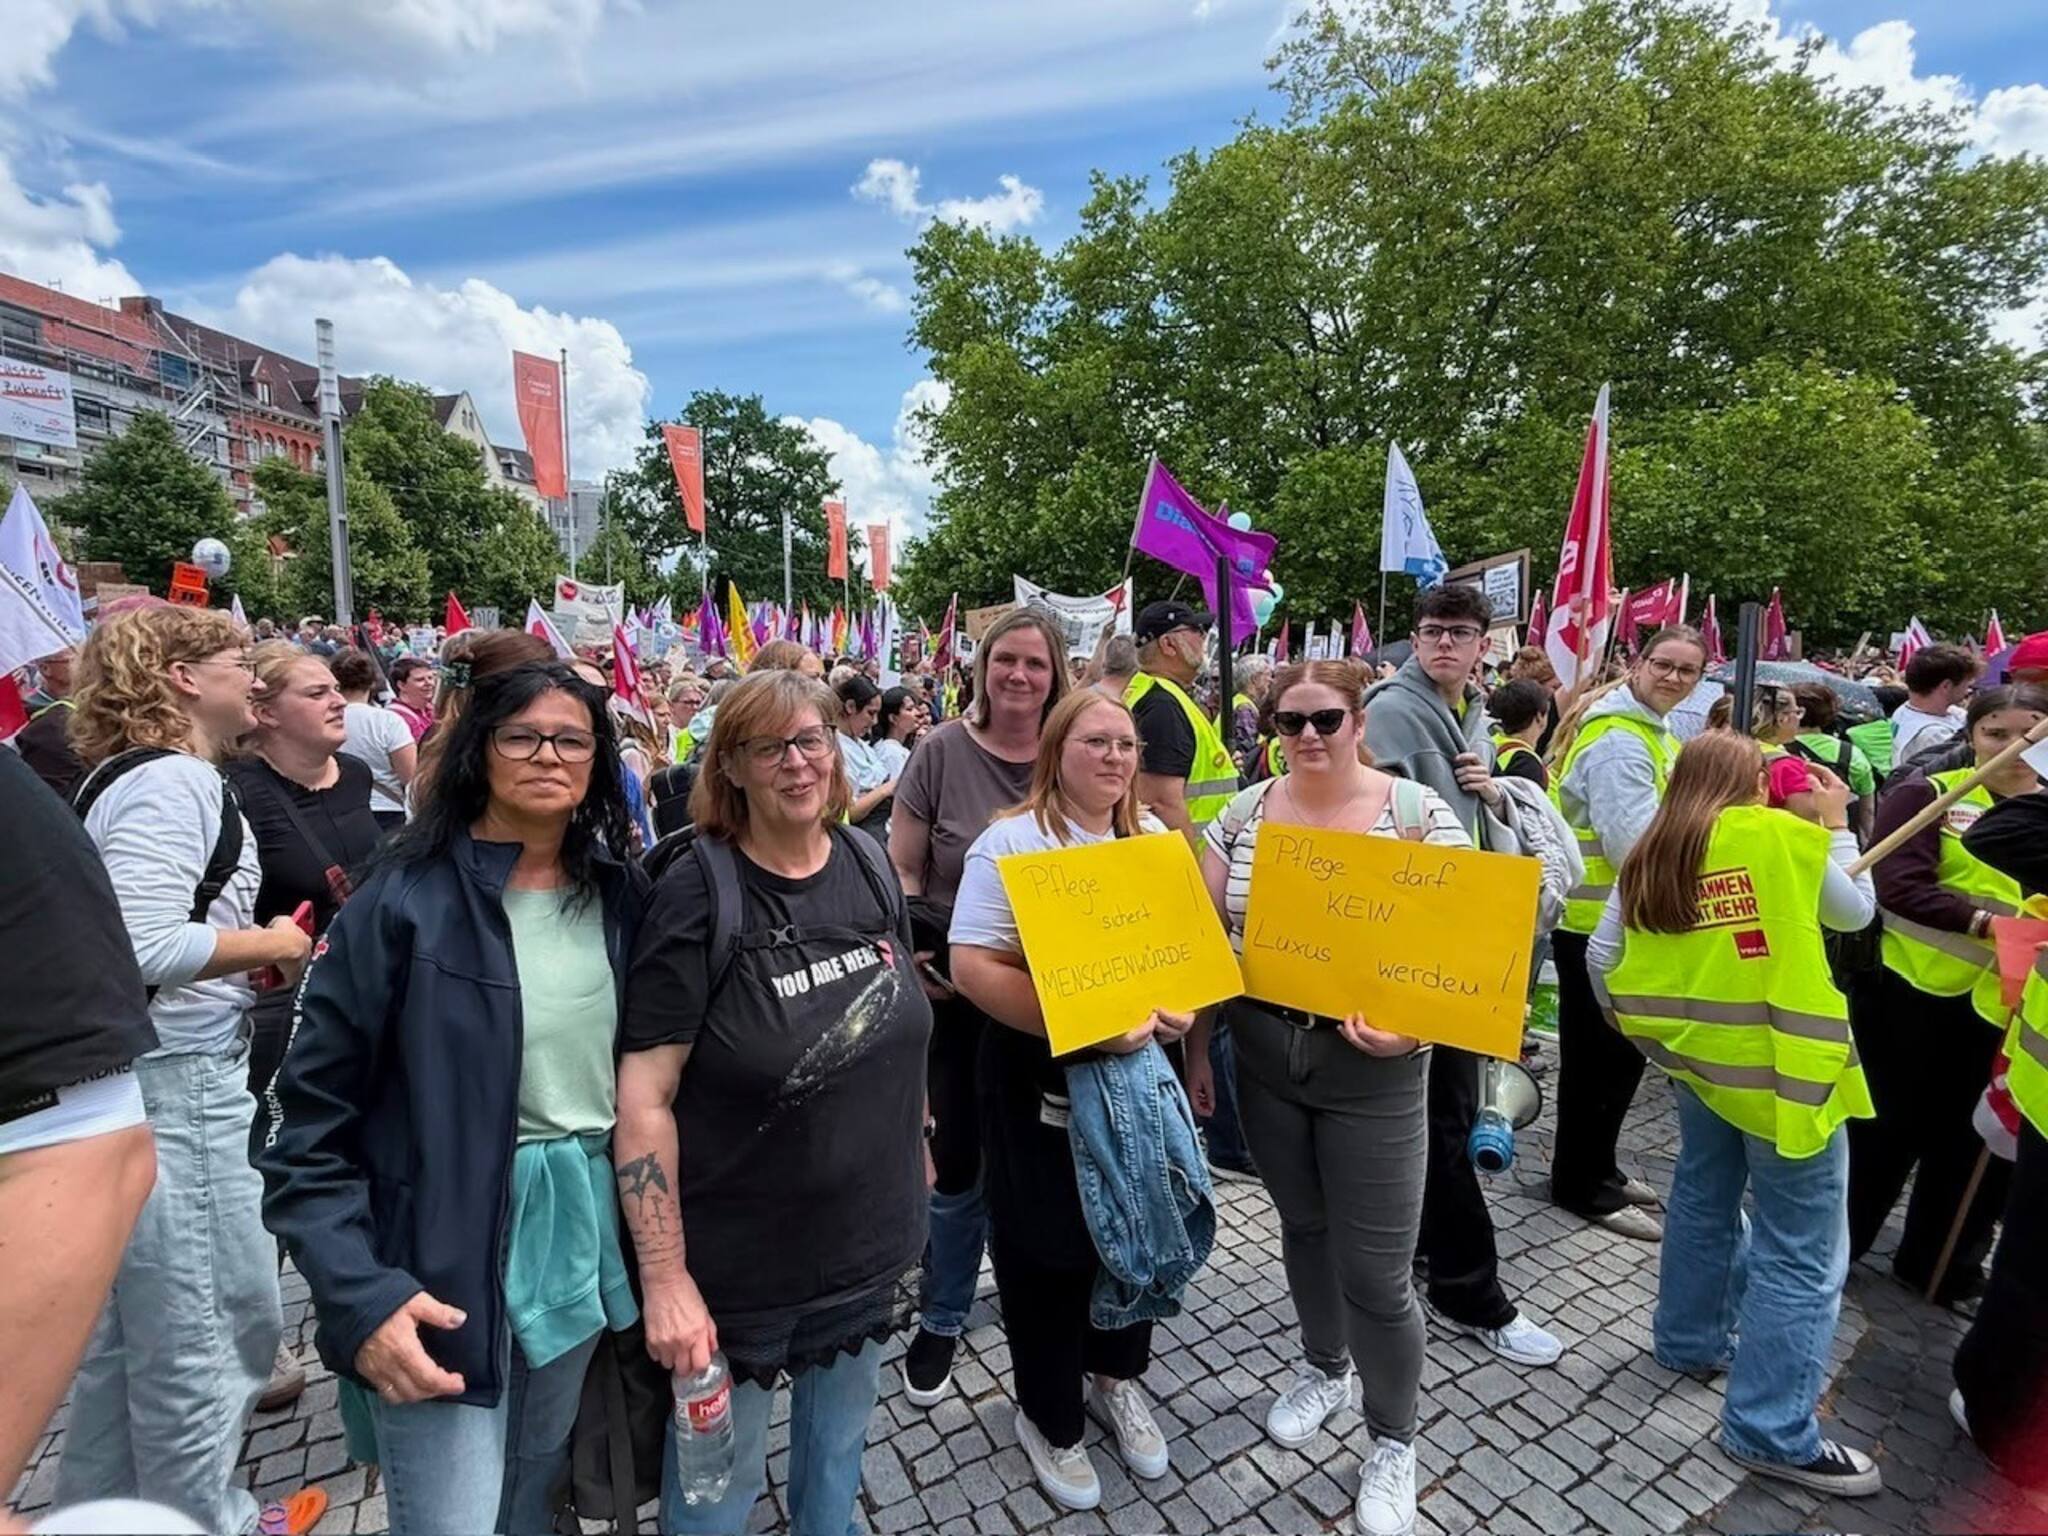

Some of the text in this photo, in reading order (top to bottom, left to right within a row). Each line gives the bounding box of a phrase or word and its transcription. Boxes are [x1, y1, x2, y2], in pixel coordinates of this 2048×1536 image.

[1272, 834, 1456, 888] Pflege darf
[1020, 864, 1101, 916] Pflege
[1326, 890, 1395, 923] KEIN
[1712, 896, 1759, 920] MEHR
[1101, 902, 1151, 930] sichert
[1252, 918, 1332, 963] Luxus
[771, 968, 811, 998] YOU
[809, 956, 845, 987] ARE
[1041, 943, 1193, 999] MENSCHENWÜRDE
